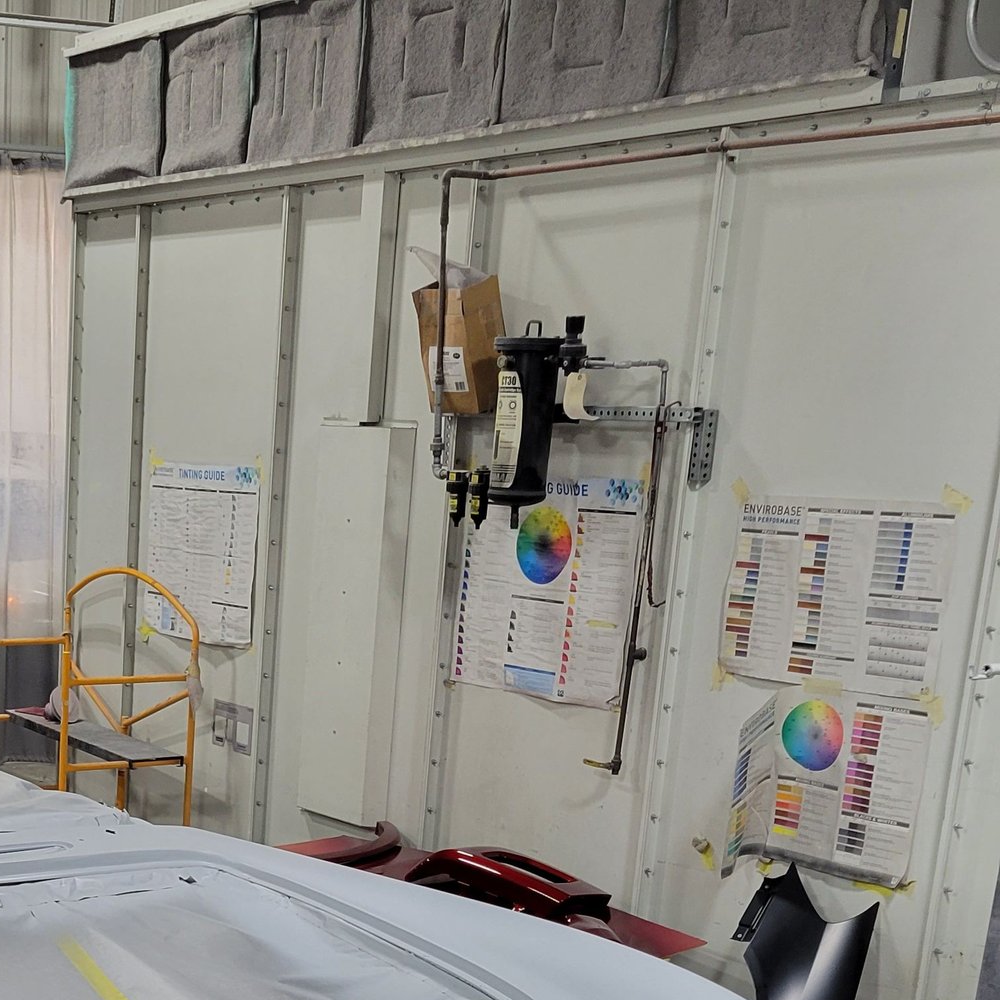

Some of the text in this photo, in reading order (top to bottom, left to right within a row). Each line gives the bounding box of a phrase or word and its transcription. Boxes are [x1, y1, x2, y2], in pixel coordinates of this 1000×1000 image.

[178, 468, 203, 480] TINTING
[203, 470, 225, 481] GUIDE
[556, 482, 589, 496] GUIDE
